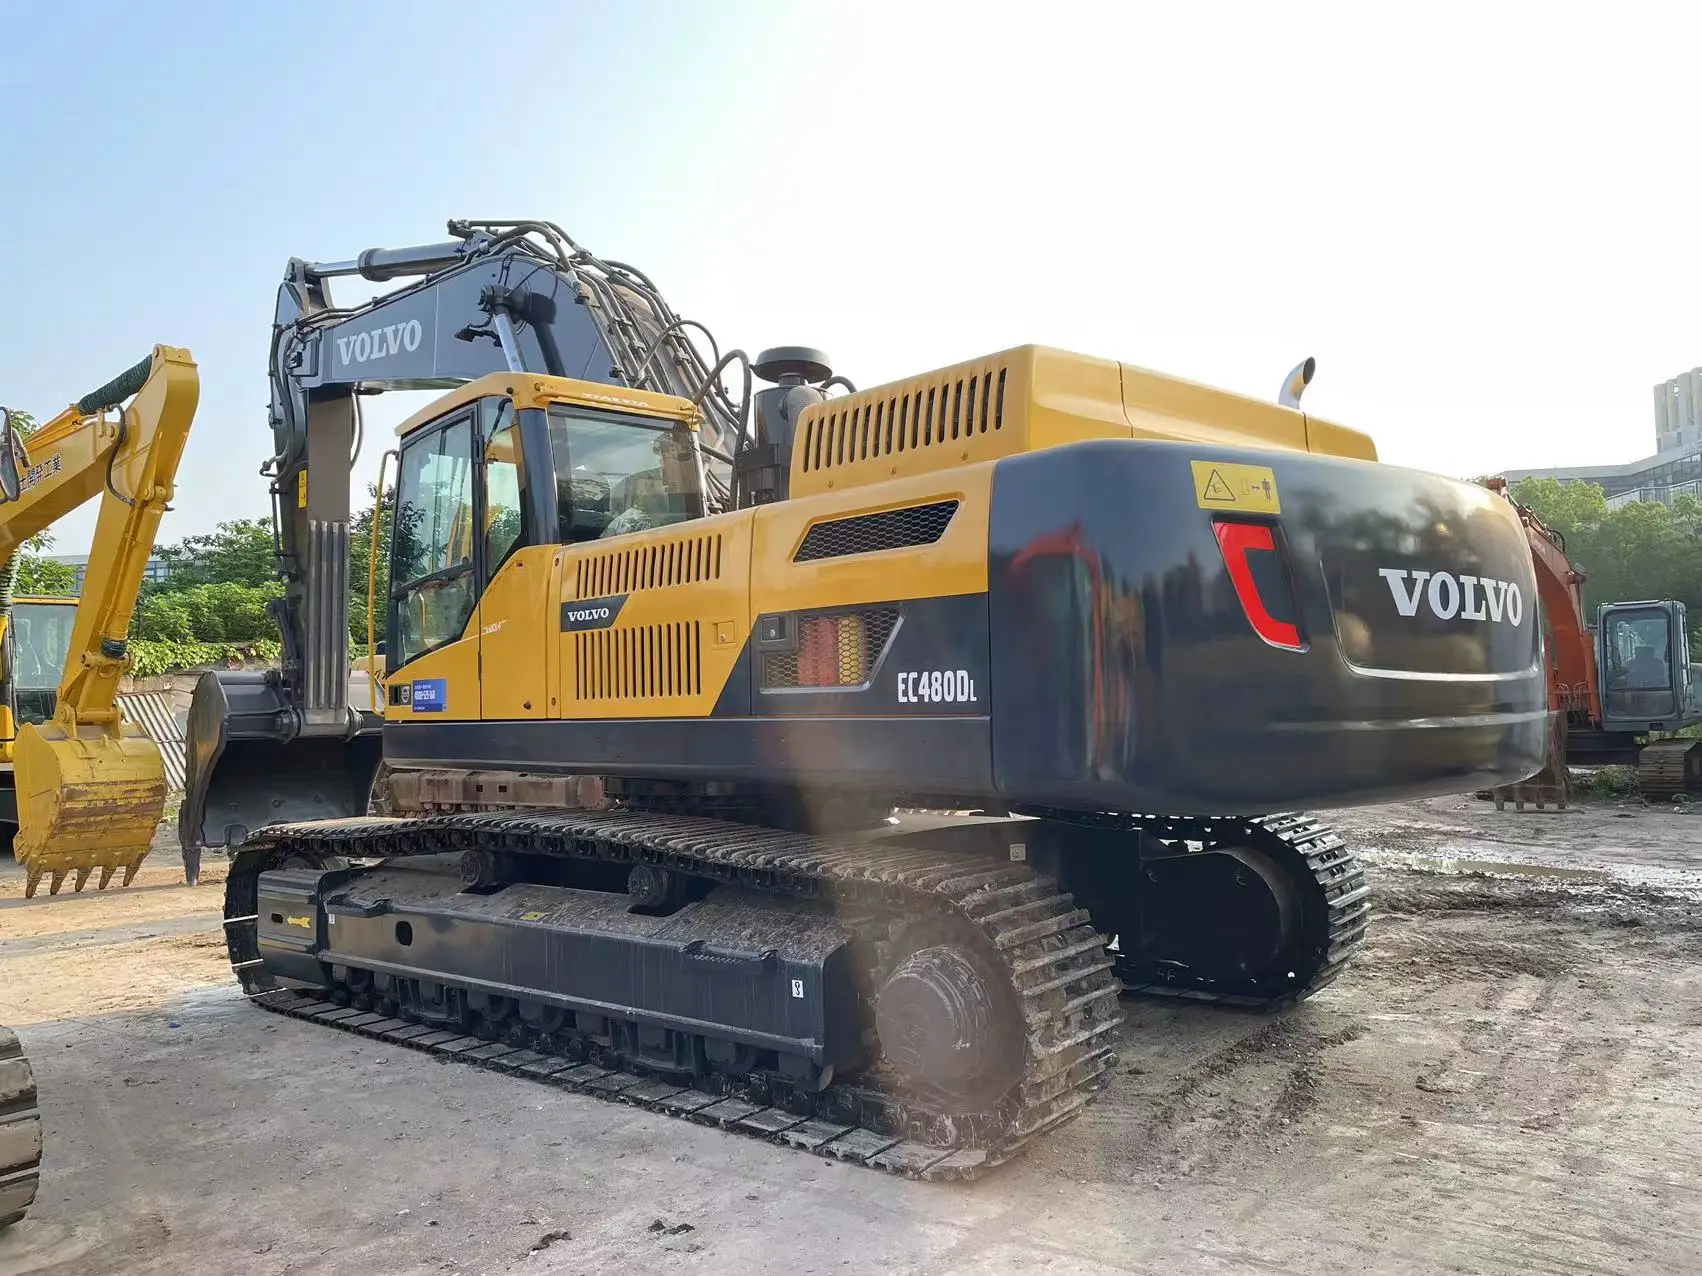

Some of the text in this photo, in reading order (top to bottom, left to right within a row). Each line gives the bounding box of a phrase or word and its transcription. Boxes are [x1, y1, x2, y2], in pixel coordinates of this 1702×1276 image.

[337, 319, 422, 365] VOLVO
[567, 607, 610, 622] VOLVO
[1378, 568, 1523, 627] VOLVO
[897, 670, 977, 703] EC480DL
